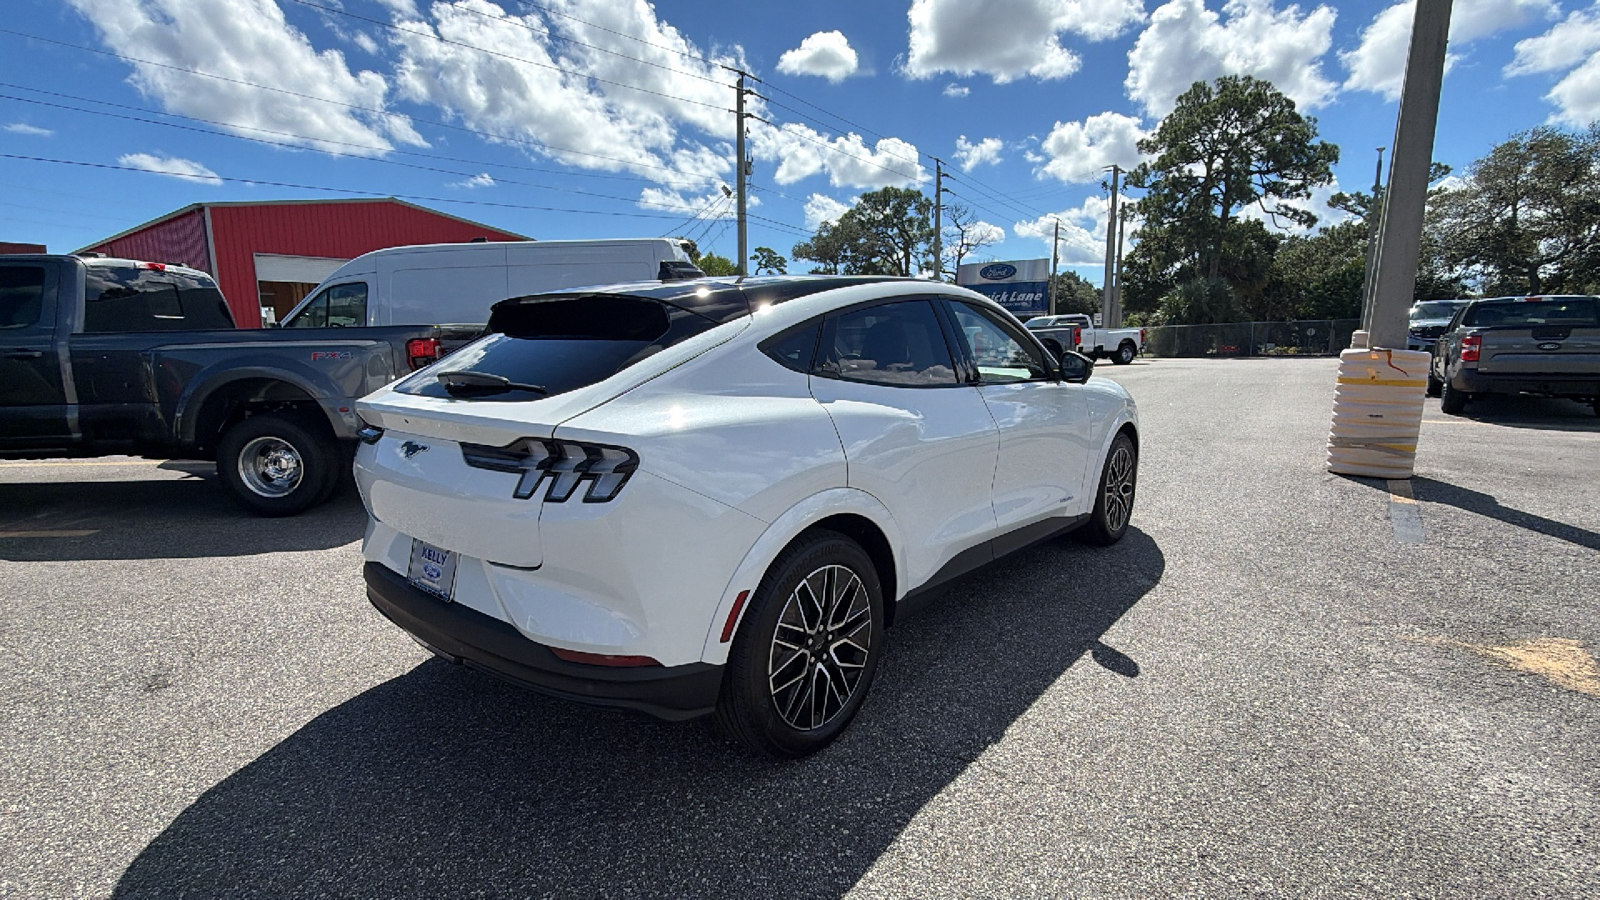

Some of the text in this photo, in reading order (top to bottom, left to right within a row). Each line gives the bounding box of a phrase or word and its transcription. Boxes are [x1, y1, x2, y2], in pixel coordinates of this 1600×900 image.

[986, 267, 1007, 276] Ford
[1010, 291, 1043, 302] Lane
[312, 351, 353, 360] FX4
[421, 546, 447, 566] KELLY
